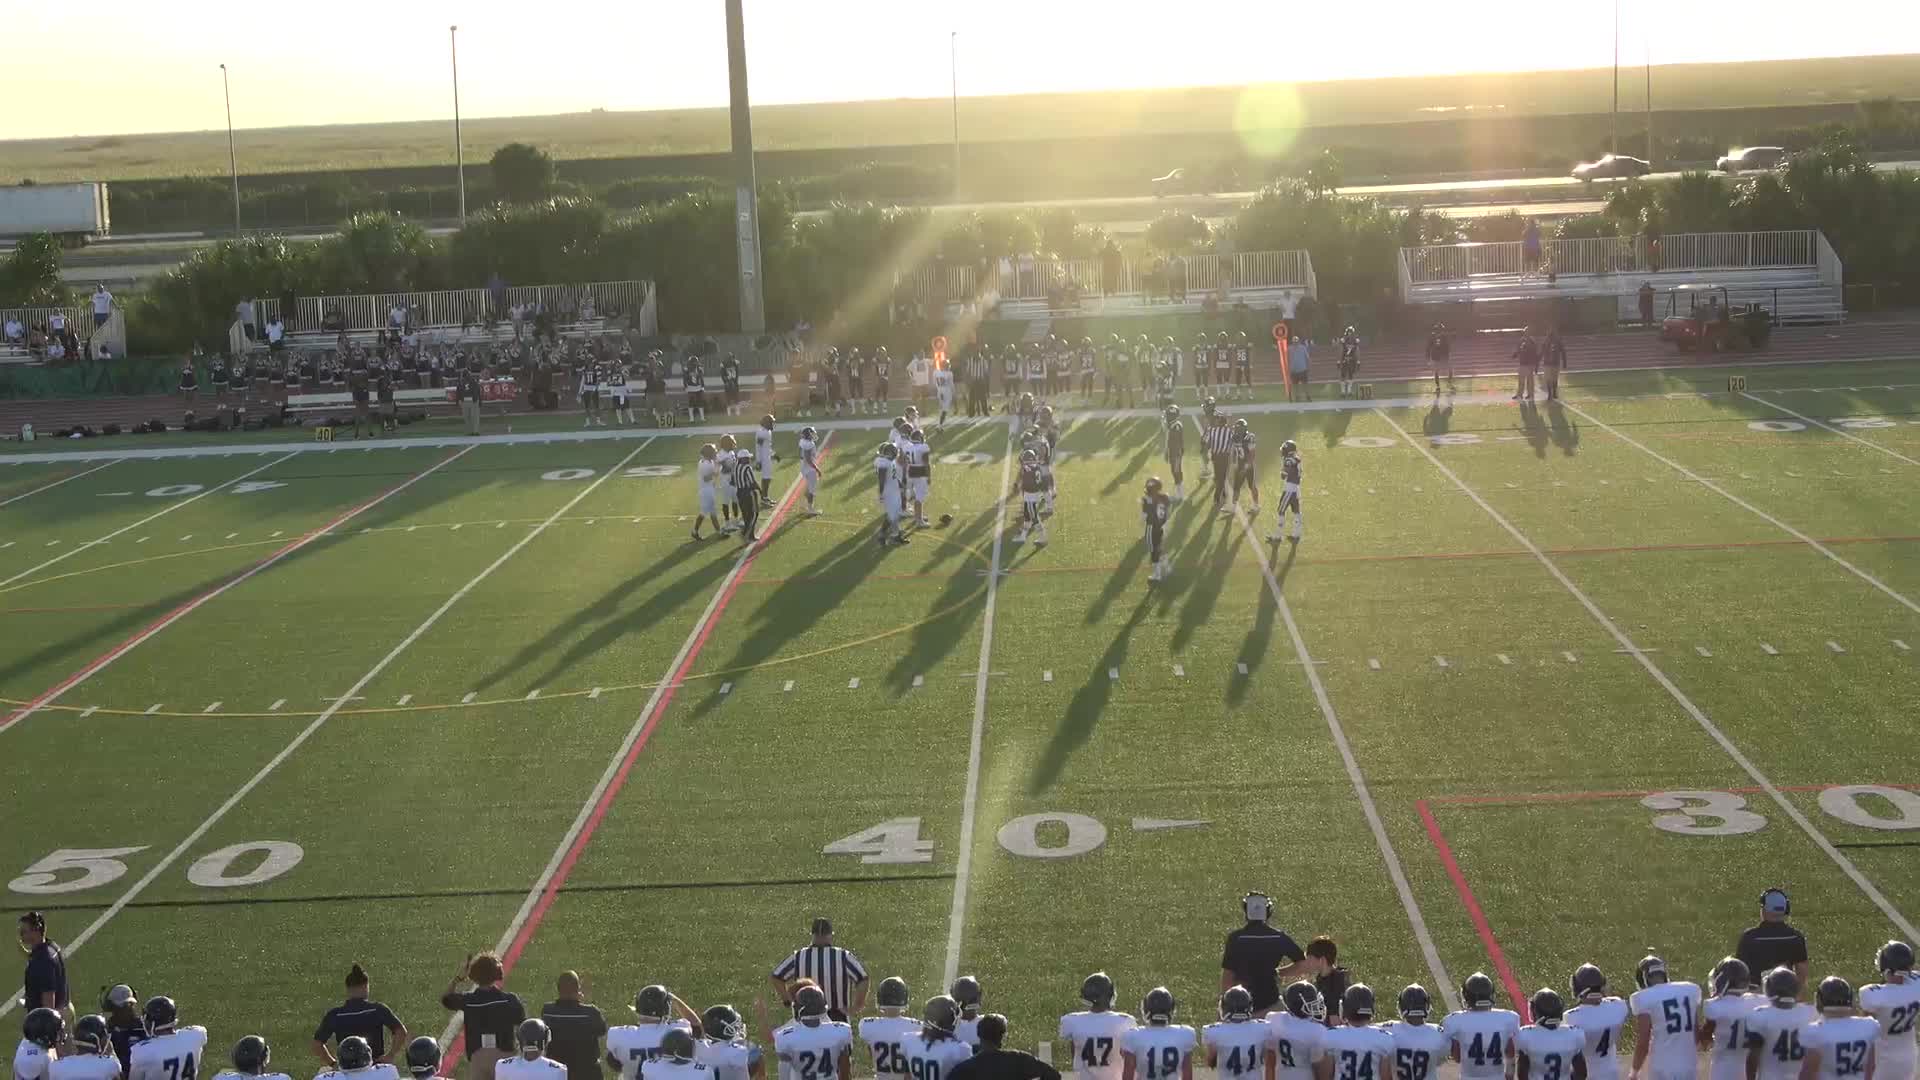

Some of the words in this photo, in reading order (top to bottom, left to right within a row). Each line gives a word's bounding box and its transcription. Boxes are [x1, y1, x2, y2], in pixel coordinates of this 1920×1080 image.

[1662, 996, 1693, 1035] 51
[800, 1048, 833, 1080] 24
[874, 1041, 908, 1073] 26
[1081, 1037, 1113, 1067] 47
[1146, 1046, 1179, 1080] 19
[1225, 1045, 1256, 1075] 41
[1467, 1031, 1503, 1066] 44
[1835, 1041, 1868, 1076] 52
[163, 1051, 195, 1080] 74
[911, 1056, 939, 1080] 90
[1341, 1050, 1374, 1080] 34
[1544, 1052, 1562, 1080] 3
